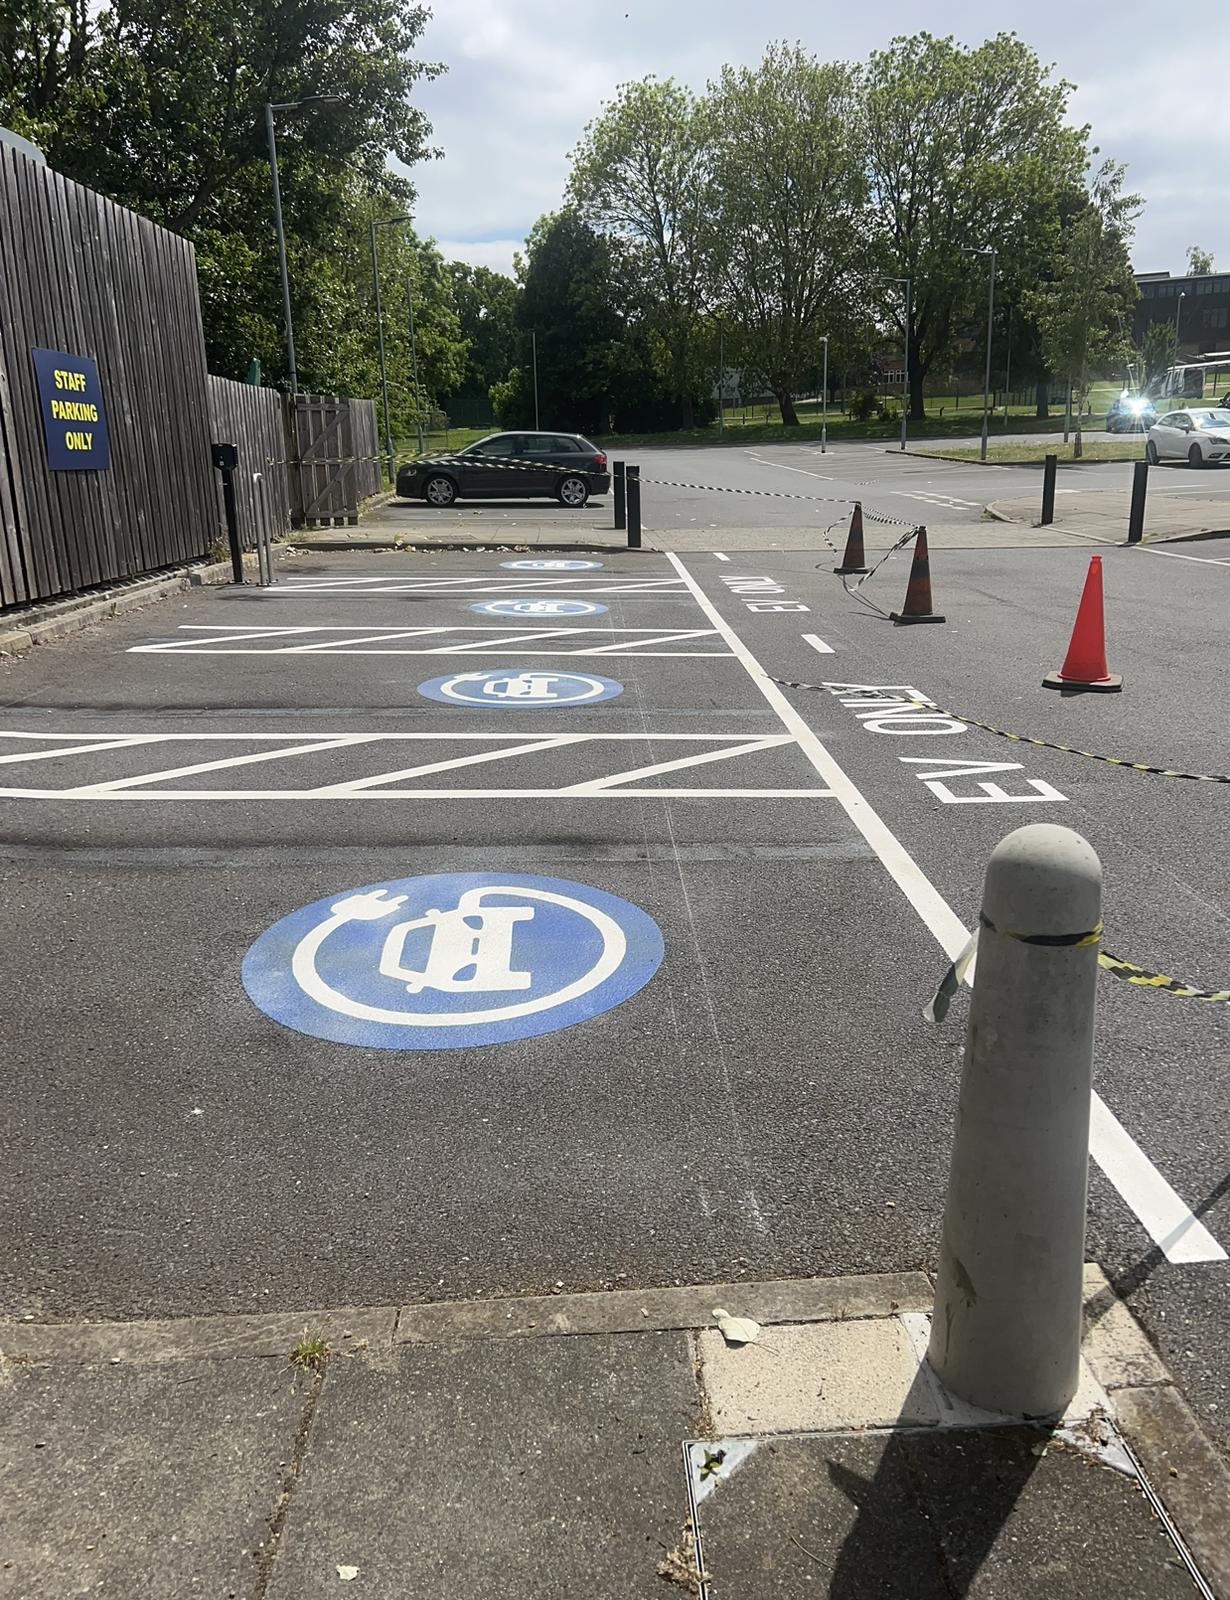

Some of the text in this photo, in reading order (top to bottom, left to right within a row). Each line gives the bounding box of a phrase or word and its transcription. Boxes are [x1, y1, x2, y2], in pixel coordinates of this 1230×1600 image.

[54, 369, 86, 392] STAFF
[51, 400, 98, 422] PARKING
[65, 431, 93, 450] ONLY
[719, 575, 811, 612] EV ONLY
[821, 681, 1070, 804] EV ONLY
